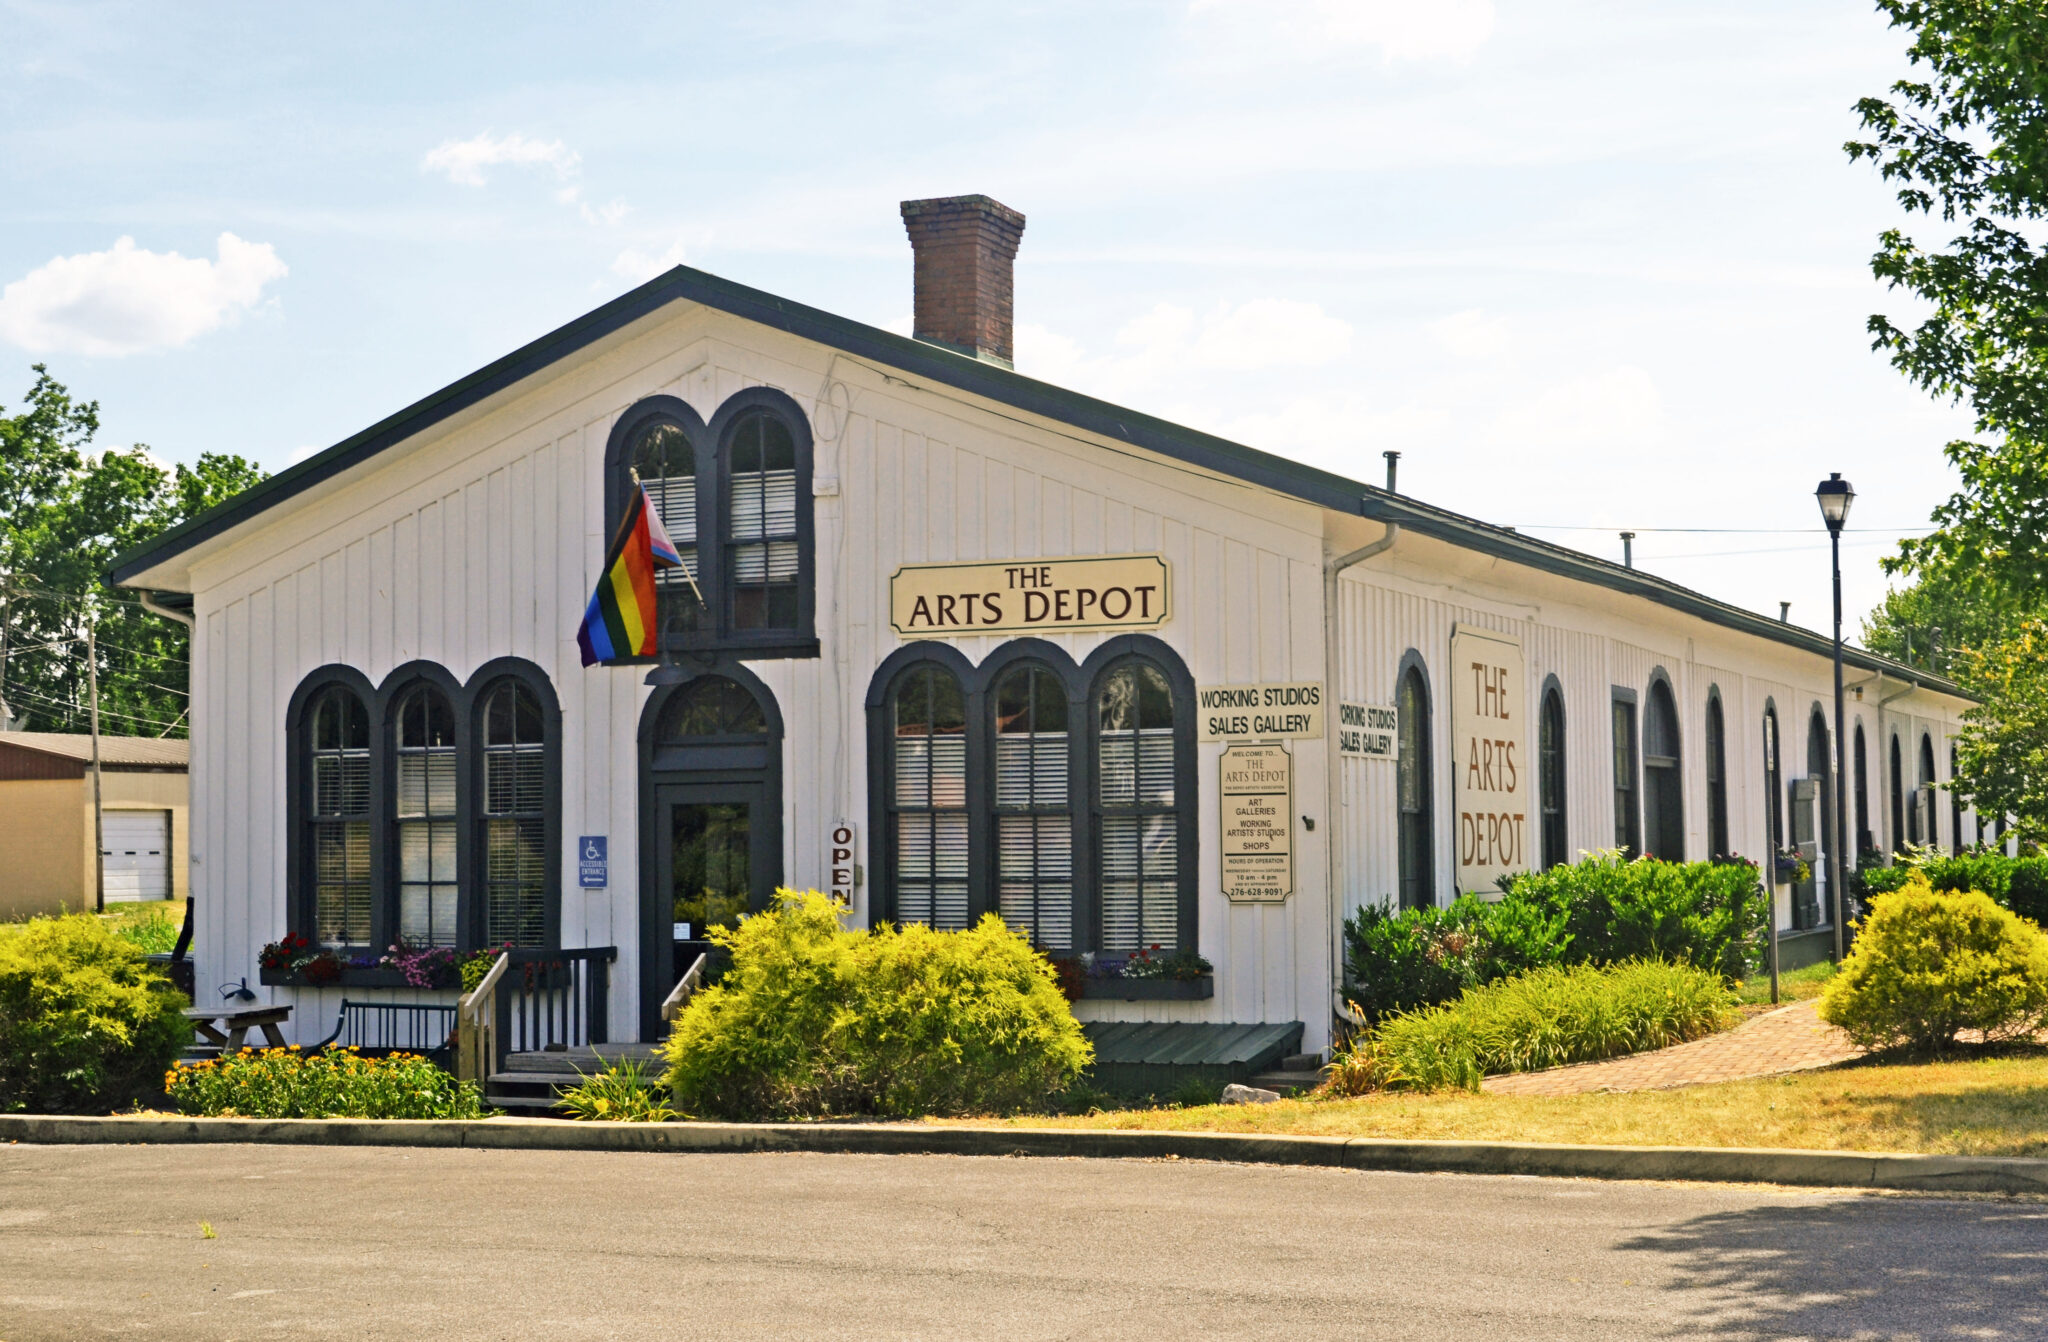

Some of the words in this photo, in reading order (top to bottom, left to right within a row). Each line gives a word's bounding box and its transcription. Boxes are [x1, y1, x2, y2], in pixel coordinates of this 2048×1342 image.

[1005, 567, 1053, 589] THE
[908, 592, 1003, 627] ARTS
[1024, 586, 1156, 623] DEPOT
[1201, 689, 1259, 708] WORKING
[1264, 687, 1320, 706] STUDIOS
[1471, 662, 1509, 719] THE
[1209, 716, 1249, 735] SALES
[1254, 714, 1311, 733] GALLERY
[1368, 707, 1396, 730] STUDIOS
[1340, 730, 1361, 753] SALES
[1363, 733, 1392, 756] GALLERY
[1246, 759, 1265, 770] THE
[1467, 737, 1517, 793] ARTS
[1225, 771, 1249, 782] ARTS
[1252, 770, 1286, 782] DEPOT
[1248, 798, 1263, 806] ART
[1235, 807, 1276, 816] GALLERIES
[1240, 820, 1272, 828] WORKING
[1257, 828, 1285, 837] STUDIOS
[1461, 812, 1525, 866] DEPOT
[1242, 842, 1270, 850] SHOPS
[581, 867, 605, 875] ENTRANCE
[1230, 887, 1283, 896] 276-628-9091
